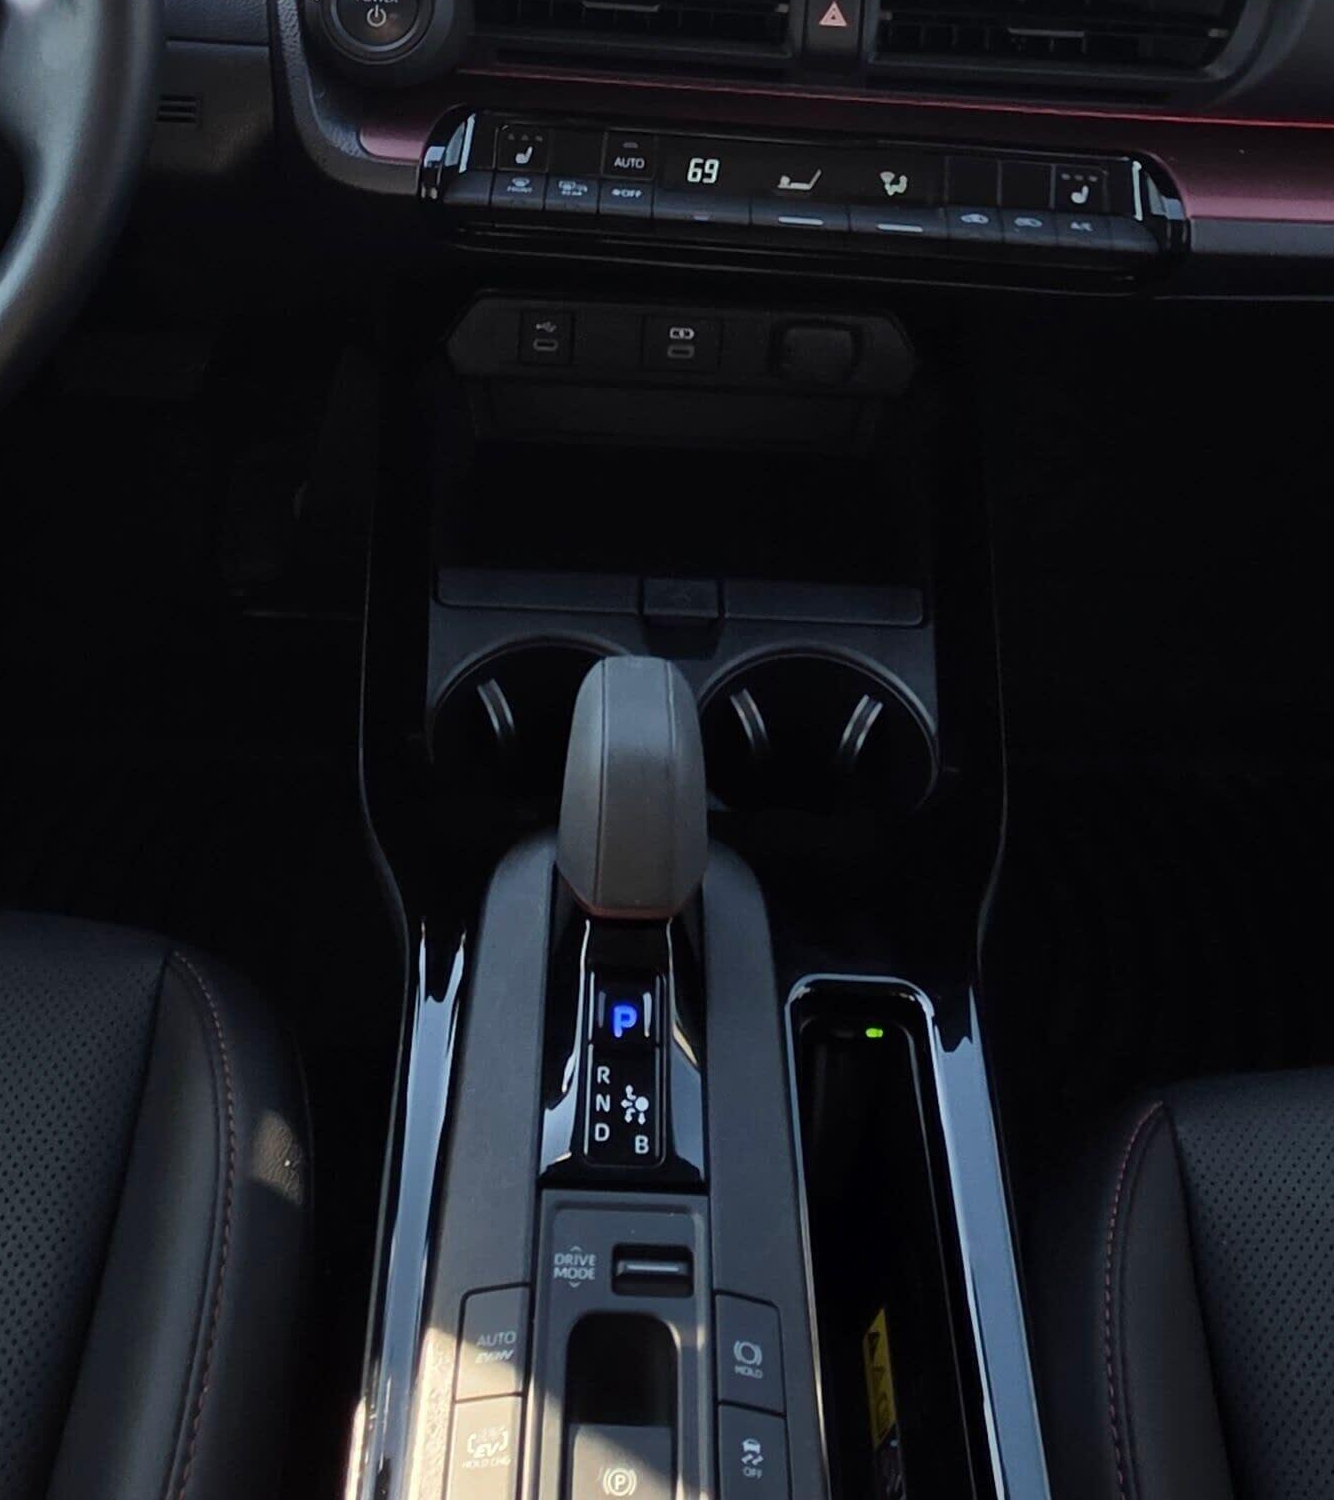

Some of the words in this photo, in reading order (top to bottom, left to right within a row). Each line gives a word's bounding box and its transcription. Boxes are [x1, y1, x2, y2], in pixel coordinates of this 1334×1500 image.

[614, 157, 645, 169] AUTO
[686, 157, 720, 184] 69
[613, 1004, 637, 1038] P
[597, 1066, 610, 1084] R
[596, 1093, 610, 1112] N
[594, 1123, 610, 1141] D
[634, 1135, 649, 1154] B
[554, 1253, 596, 1266] DRIVE
[554, 1267, 595, 1280] MODE
[477, 1331, 517, 1347] AUTO
[734, 1364, 763, 1379] HOLD
